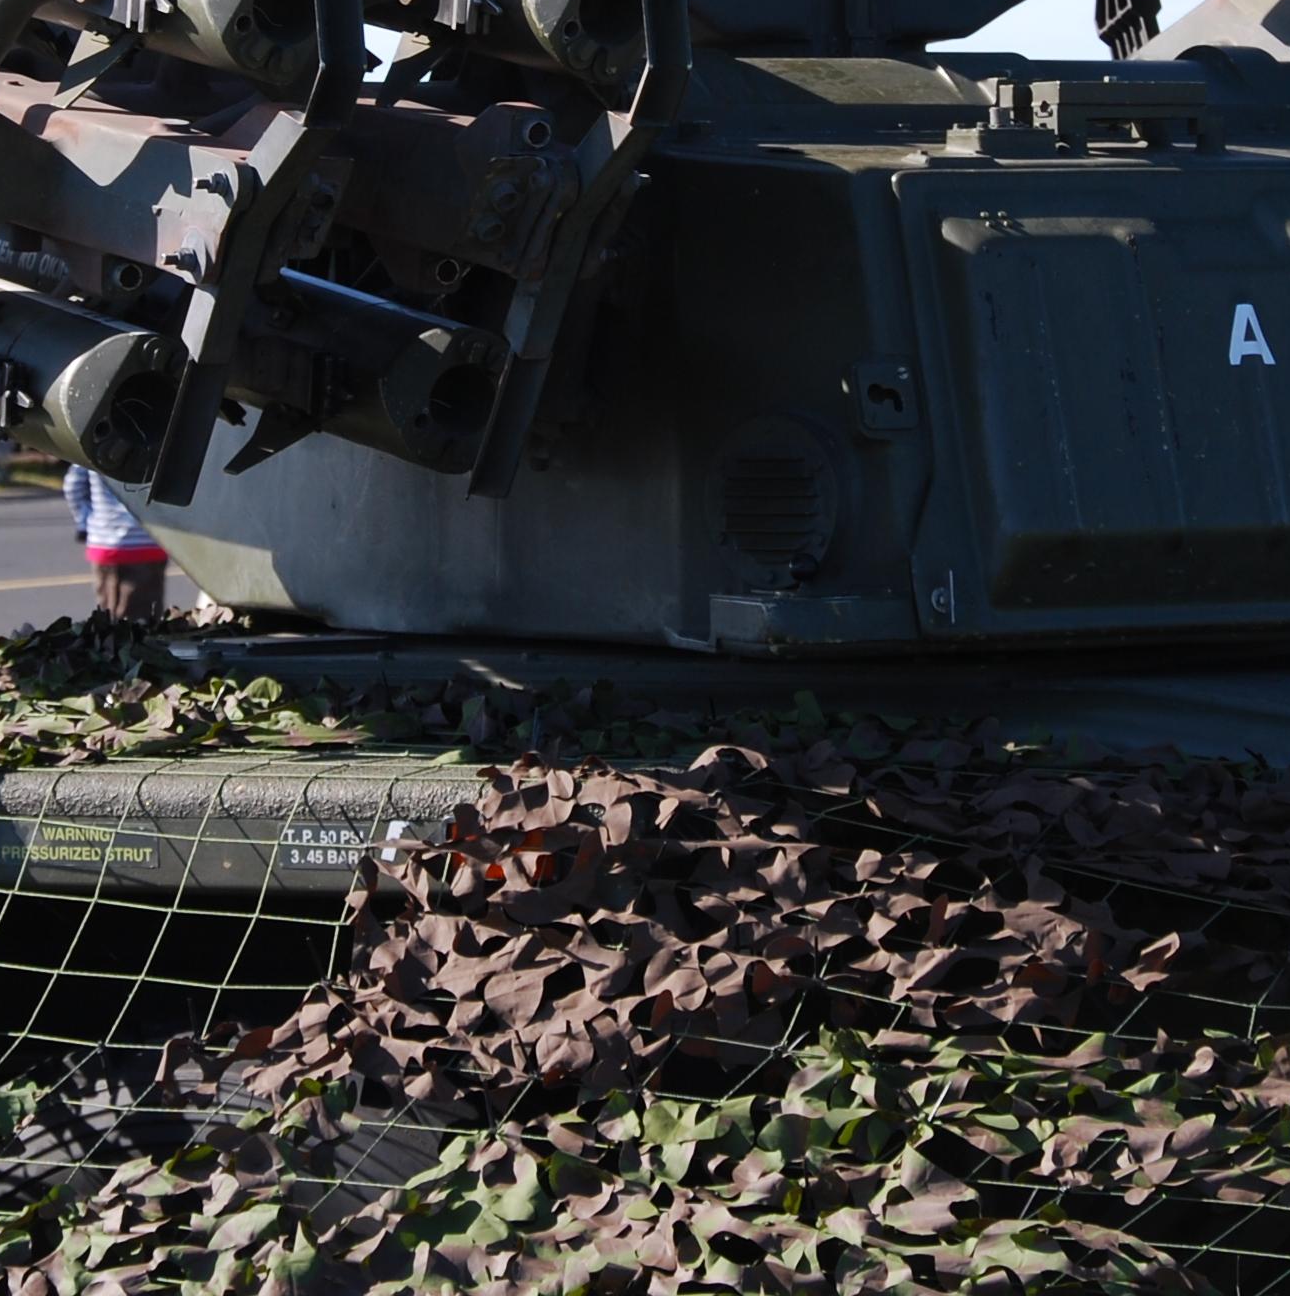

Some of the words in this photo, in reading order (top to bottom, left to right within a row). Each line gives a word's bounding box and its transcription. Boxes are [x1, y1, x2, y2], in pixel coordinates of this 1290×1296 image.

[1229, 304, 1276, 365] A
[42, 827, 110, 842] WARNING
[320, 830, 337, 844] 50
[105, 847, 153, 862] STRUT
[291, 849, 323, 864] 3.45
